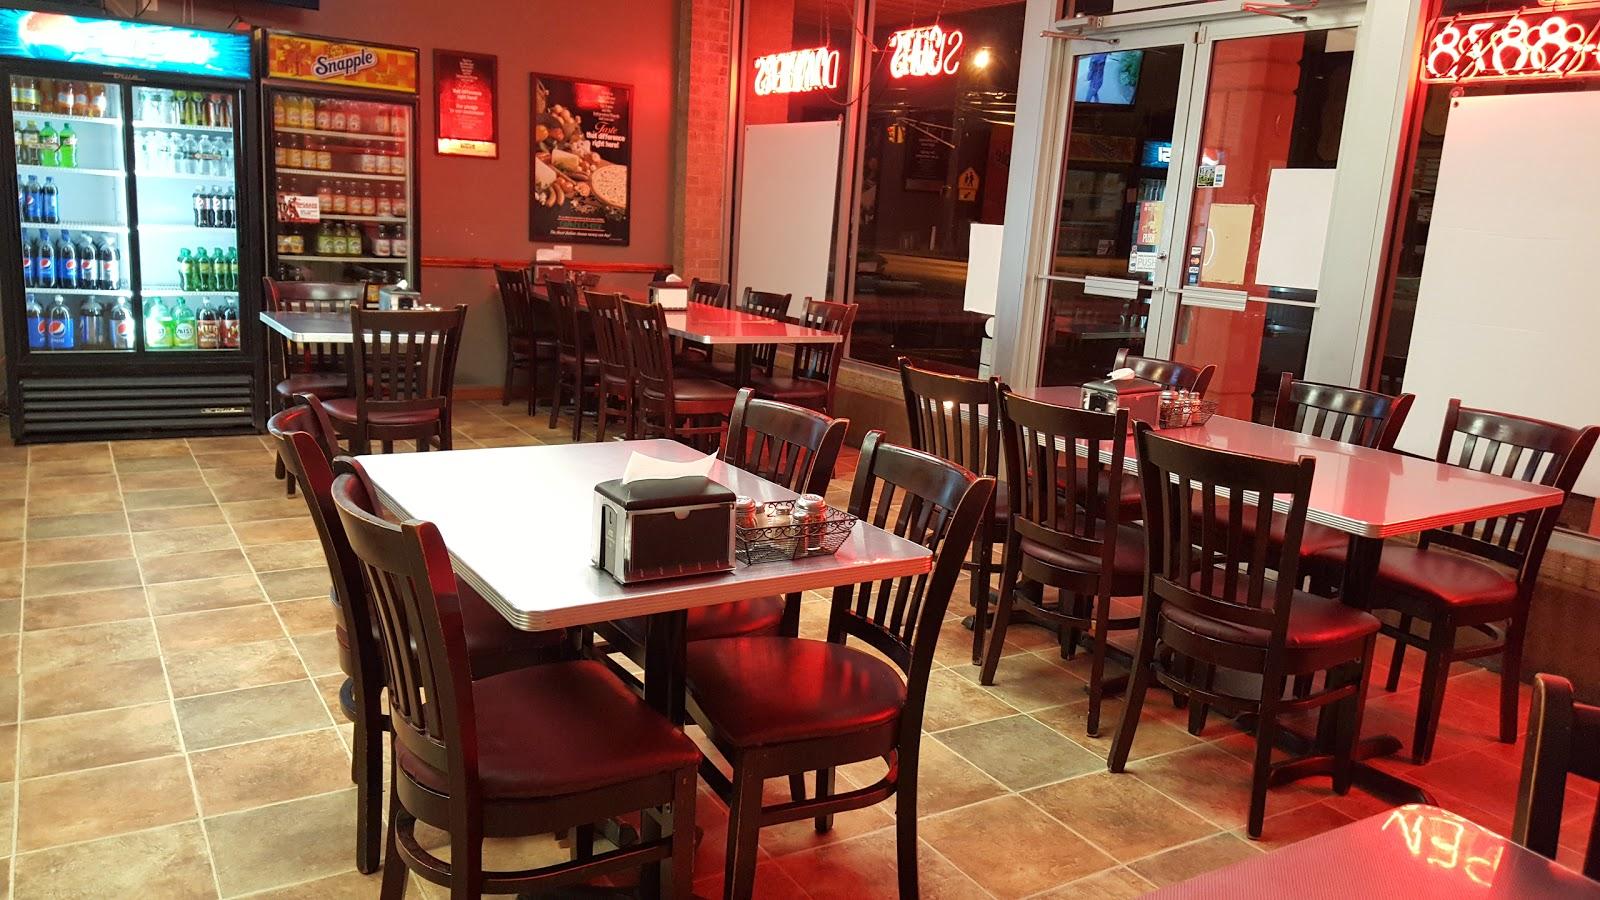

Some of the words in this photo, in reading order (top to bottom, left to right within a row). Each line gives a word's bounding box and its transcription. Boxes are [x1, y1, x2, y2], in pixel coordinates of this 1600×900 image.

[315, 48, 373, 75] Snapple
[598, 132, 626, 142] difference
[592, 140, 604, 149] right
